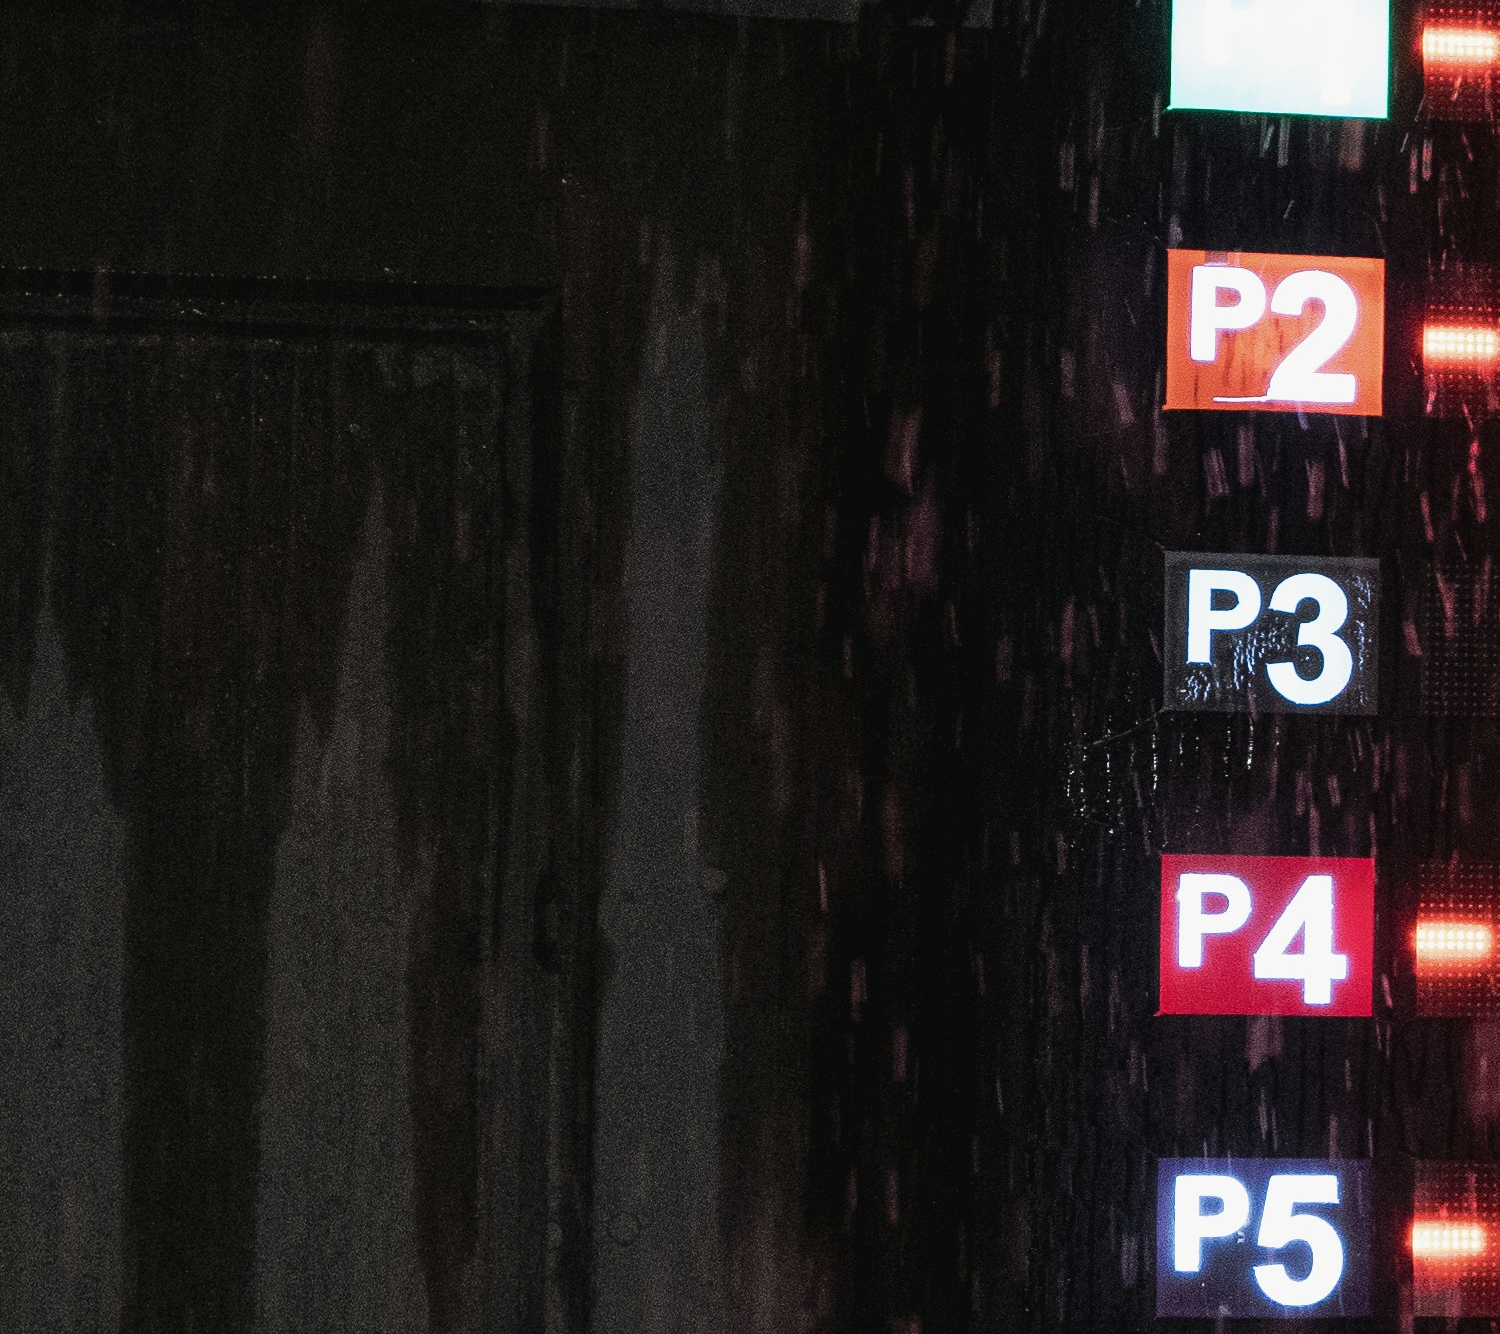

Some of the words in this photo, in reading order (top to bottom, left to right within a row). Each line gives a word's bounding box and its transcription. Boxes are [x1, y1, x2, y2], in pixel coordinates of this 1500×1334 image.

[1191, 266, 1357, 403] P2
[1187, 570, 1352, 704] P3
[1176, 873, 1347, 1004] P4
[1174, 1175, 1343, 1306] P5
